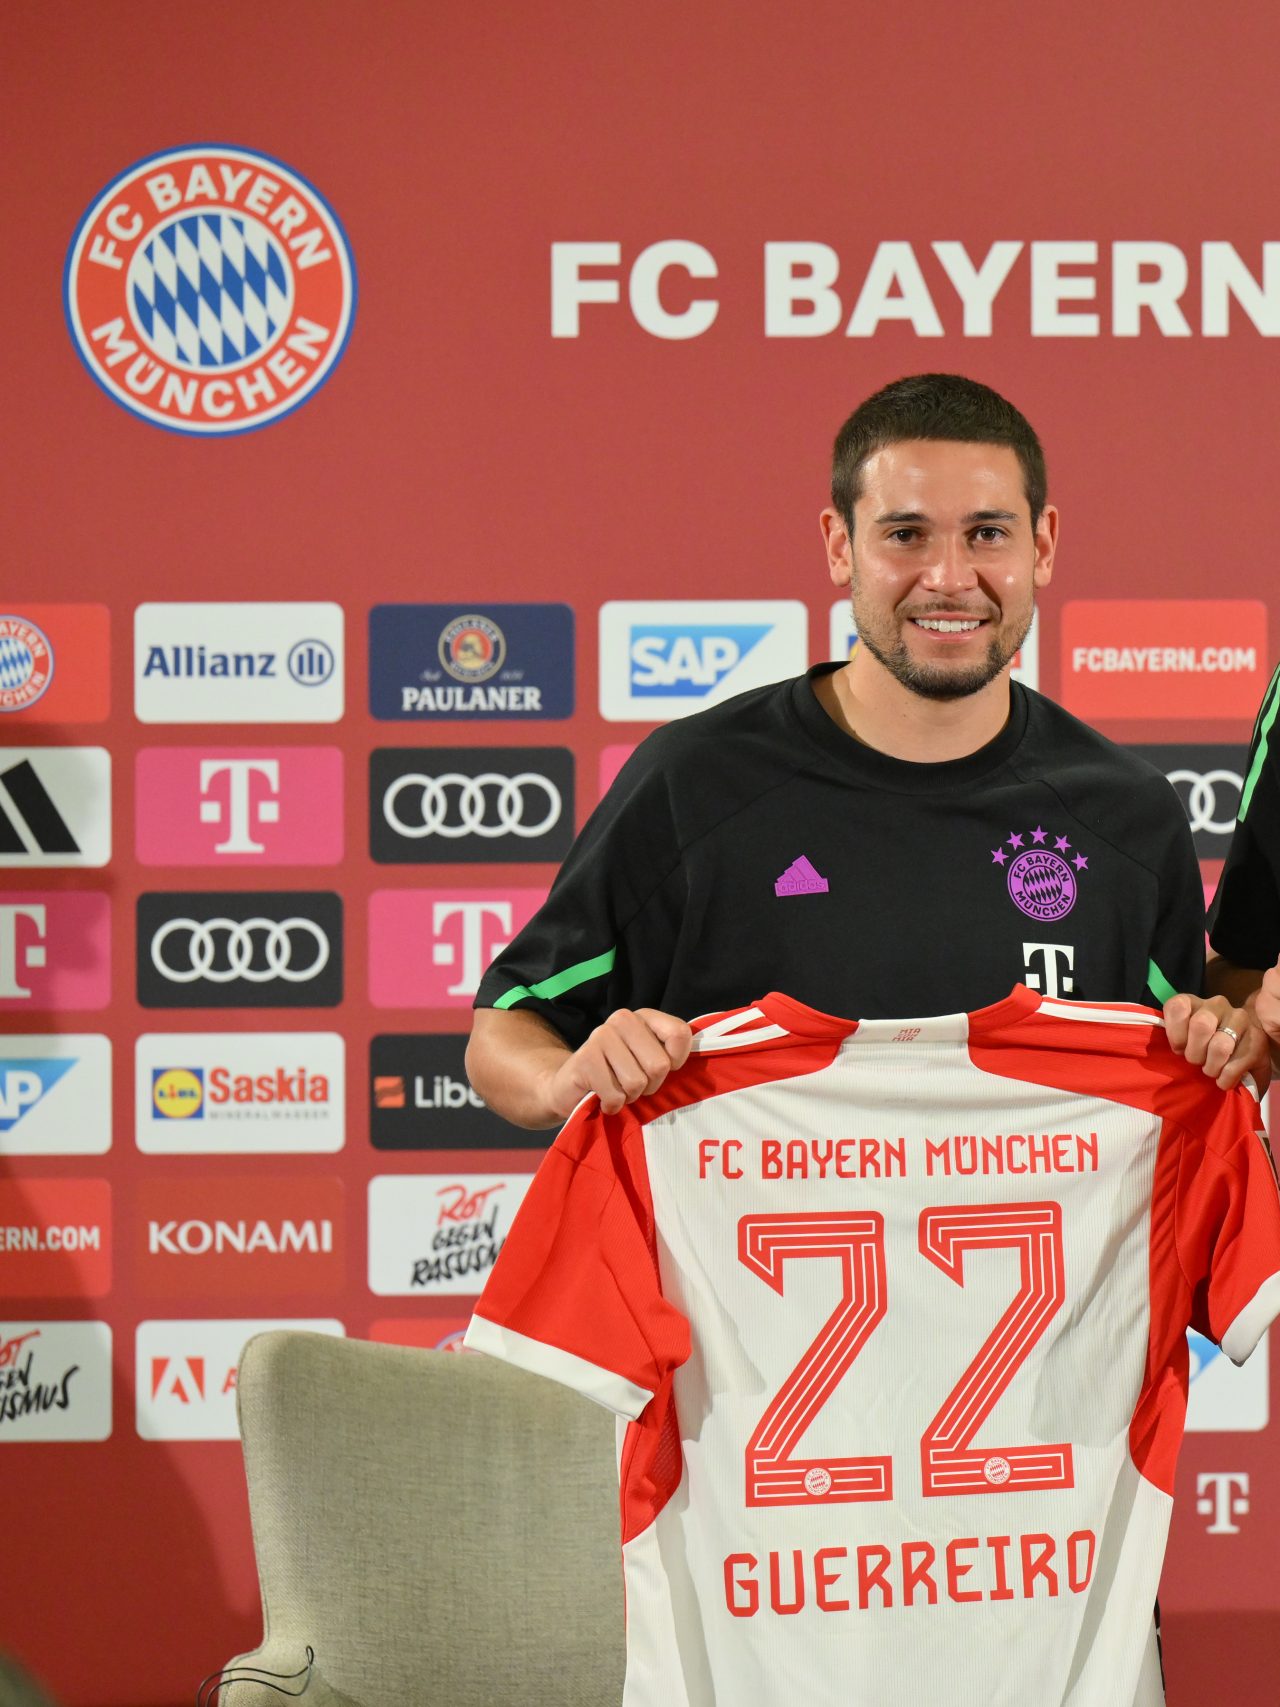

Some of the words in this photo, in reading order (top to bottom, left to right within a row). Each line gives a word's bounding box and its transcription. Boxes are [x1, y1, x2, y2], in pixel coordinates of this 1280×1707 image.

[88, 203, 144, 270] FC
[145, 164, 333, 271] BAYERN
[551, 239, 720, 340] FC
[91, 316, 331, 418] MÜNCHEN
[143, 645, 277, 679] Allianz
[631, 636, 740, 687] SAP
[1073, 647, 1257, 673] FCBAYERN.COM
[401, 686, 543, 712] PAULANER
[1013, 863, 1026, 879] FC
[1026, 855, 1070, 883] BAYERN
[209, 1066, 329, 1104] Saskia
[699, 1139, 744, 1180] FC
[761, 1137, 907, 1179] BAYERN
[925, 1132, 1099, 1176] MÜNCHEN
[148, 1220, 333, 1254] KONAMI
[737, 1200, 1075, 1508] 22
[723, 1529, 1096, 1618] GUERREIRO
